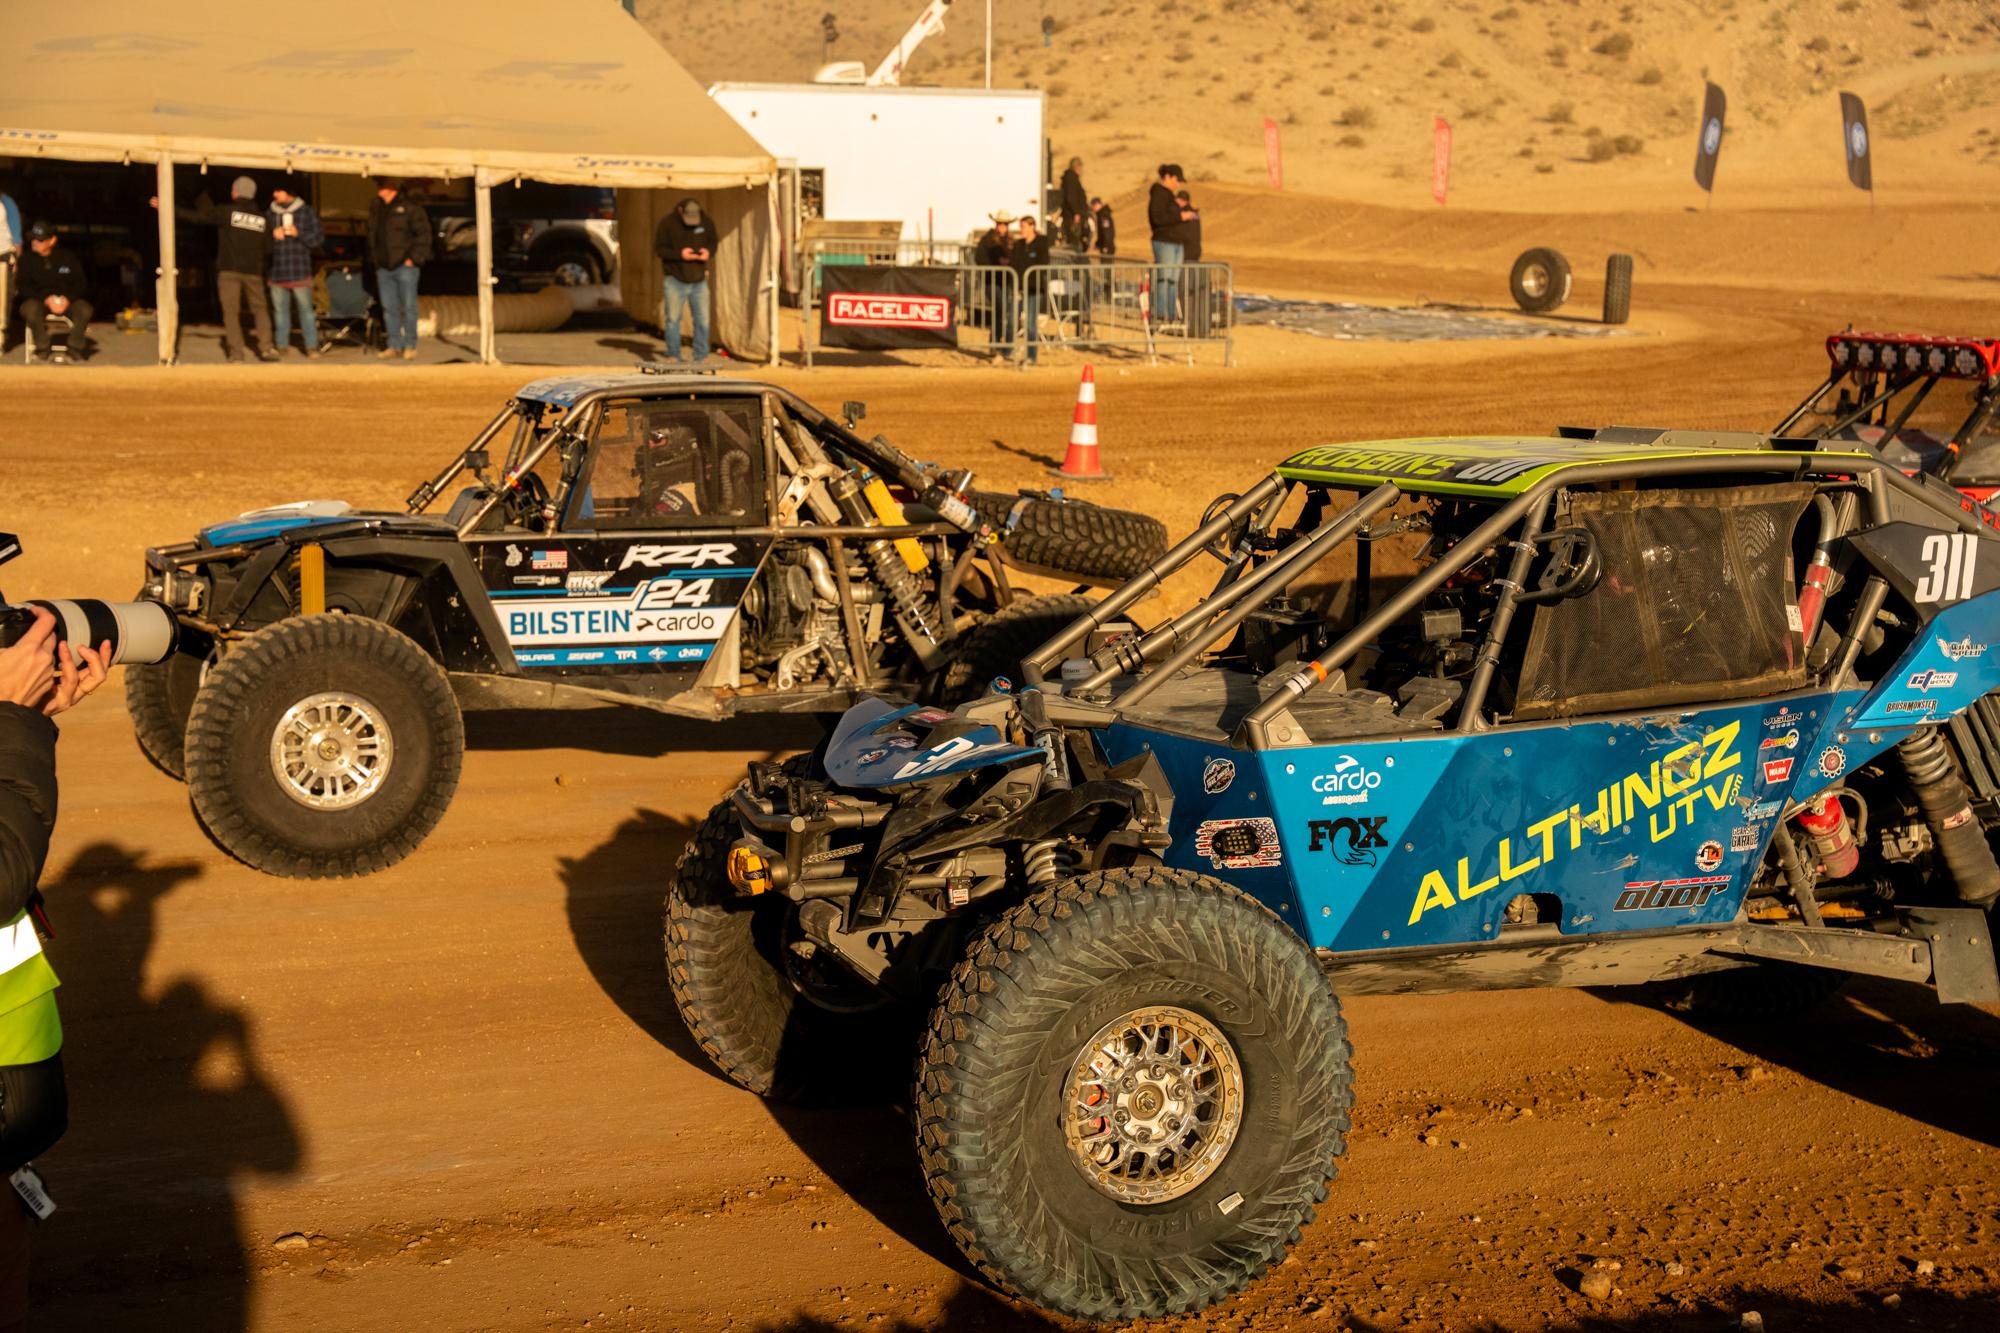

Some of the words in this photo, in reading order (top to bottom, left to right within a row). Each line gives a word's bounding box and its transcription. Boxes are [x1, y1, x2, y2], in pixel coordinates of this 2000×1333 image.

[838, 300, 942, 321] RACELINE
[1287, 447, 1473, 476] ROBBINS
[619, 543, 738, 571] RZR
[1915, 533, 1978, 603] 311
[639, 578, 714, 608] 24
[510, 609, 630, 635] BILSTEIN
[656, 611, 715, 631] cardo
[1763, 711, 1803, 726] VISION
[1311, 767, 1381, 792] cardo
[1768, 765, 1787, 777] WARN
[1650, 773, 1735, 843] UTV
[1308, 817, 1389, 867] FOX
[1731, 833, 1759, 847] GARAGE
